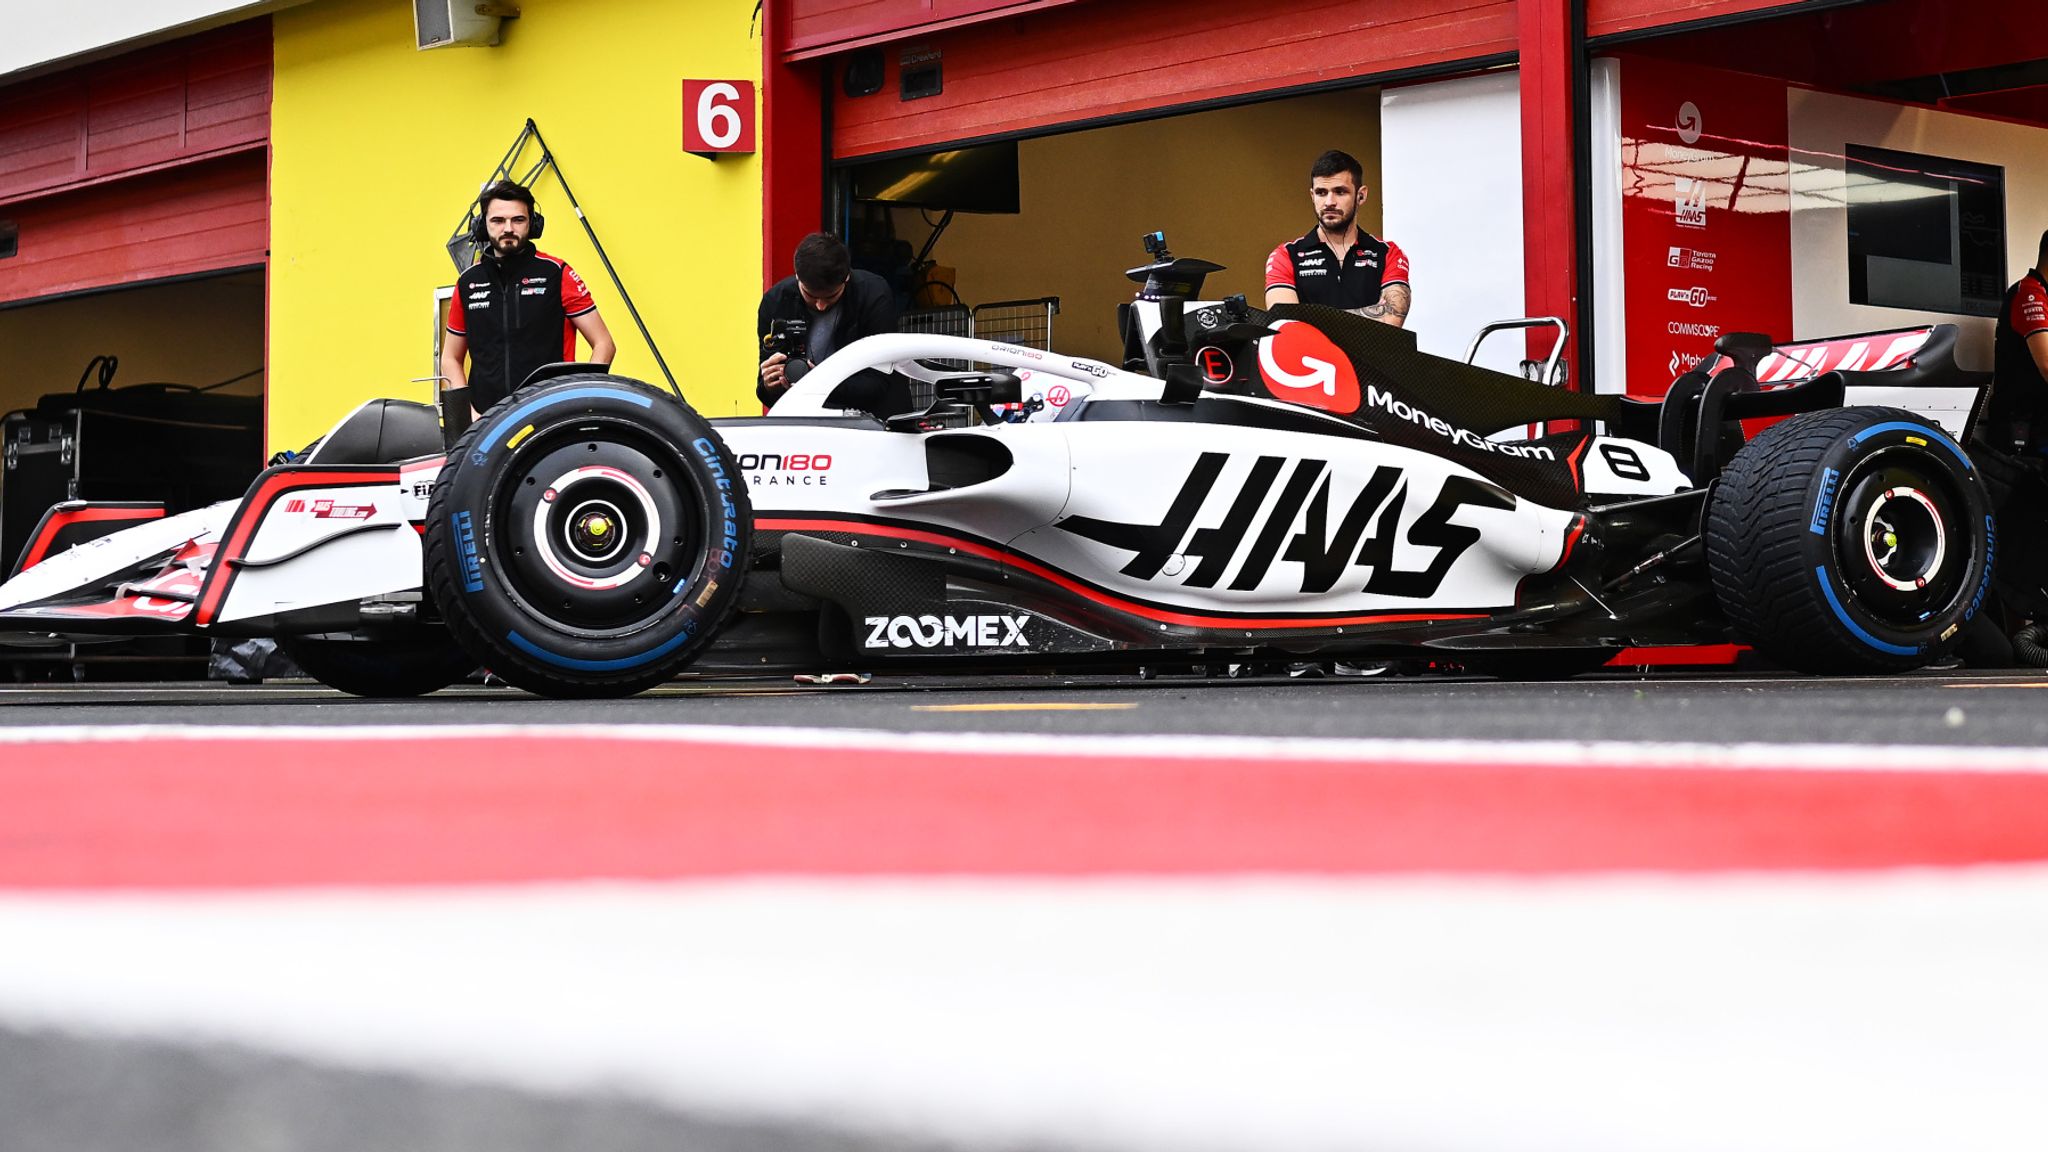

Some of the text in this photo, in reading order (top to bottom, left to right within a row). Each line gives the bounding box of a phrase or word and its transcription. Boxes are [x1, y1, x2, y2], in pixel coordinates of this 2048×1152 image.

[697, 82, 742, 149] 6
[1676, 209, 1706, 223] HAAS
[1692, 250, 1717, 259] TOYOTA
[1690, 262, 1713, 272] Racing
[1690, 288, 1707, 305] GO
[1668, 321, 1720, 338] COMMSCOPE
[1204, 351, 1226, 379] E
[1681, 352, 1704, 369] Mph
[1367, 384, 1556, 462] MoneyGram
[739, 453, 832, 471] ON180
[1598, 443, 1651, 482] 8
[753, 475, 827, 486] RANCE
[1809, 466, 1840, 536] PIRELLI
[1052, 452, 1518, 598] HAAS
[451, 510, 485, 593] PIRELLI
[865, 615, 1031, 648] ZOOMEX
